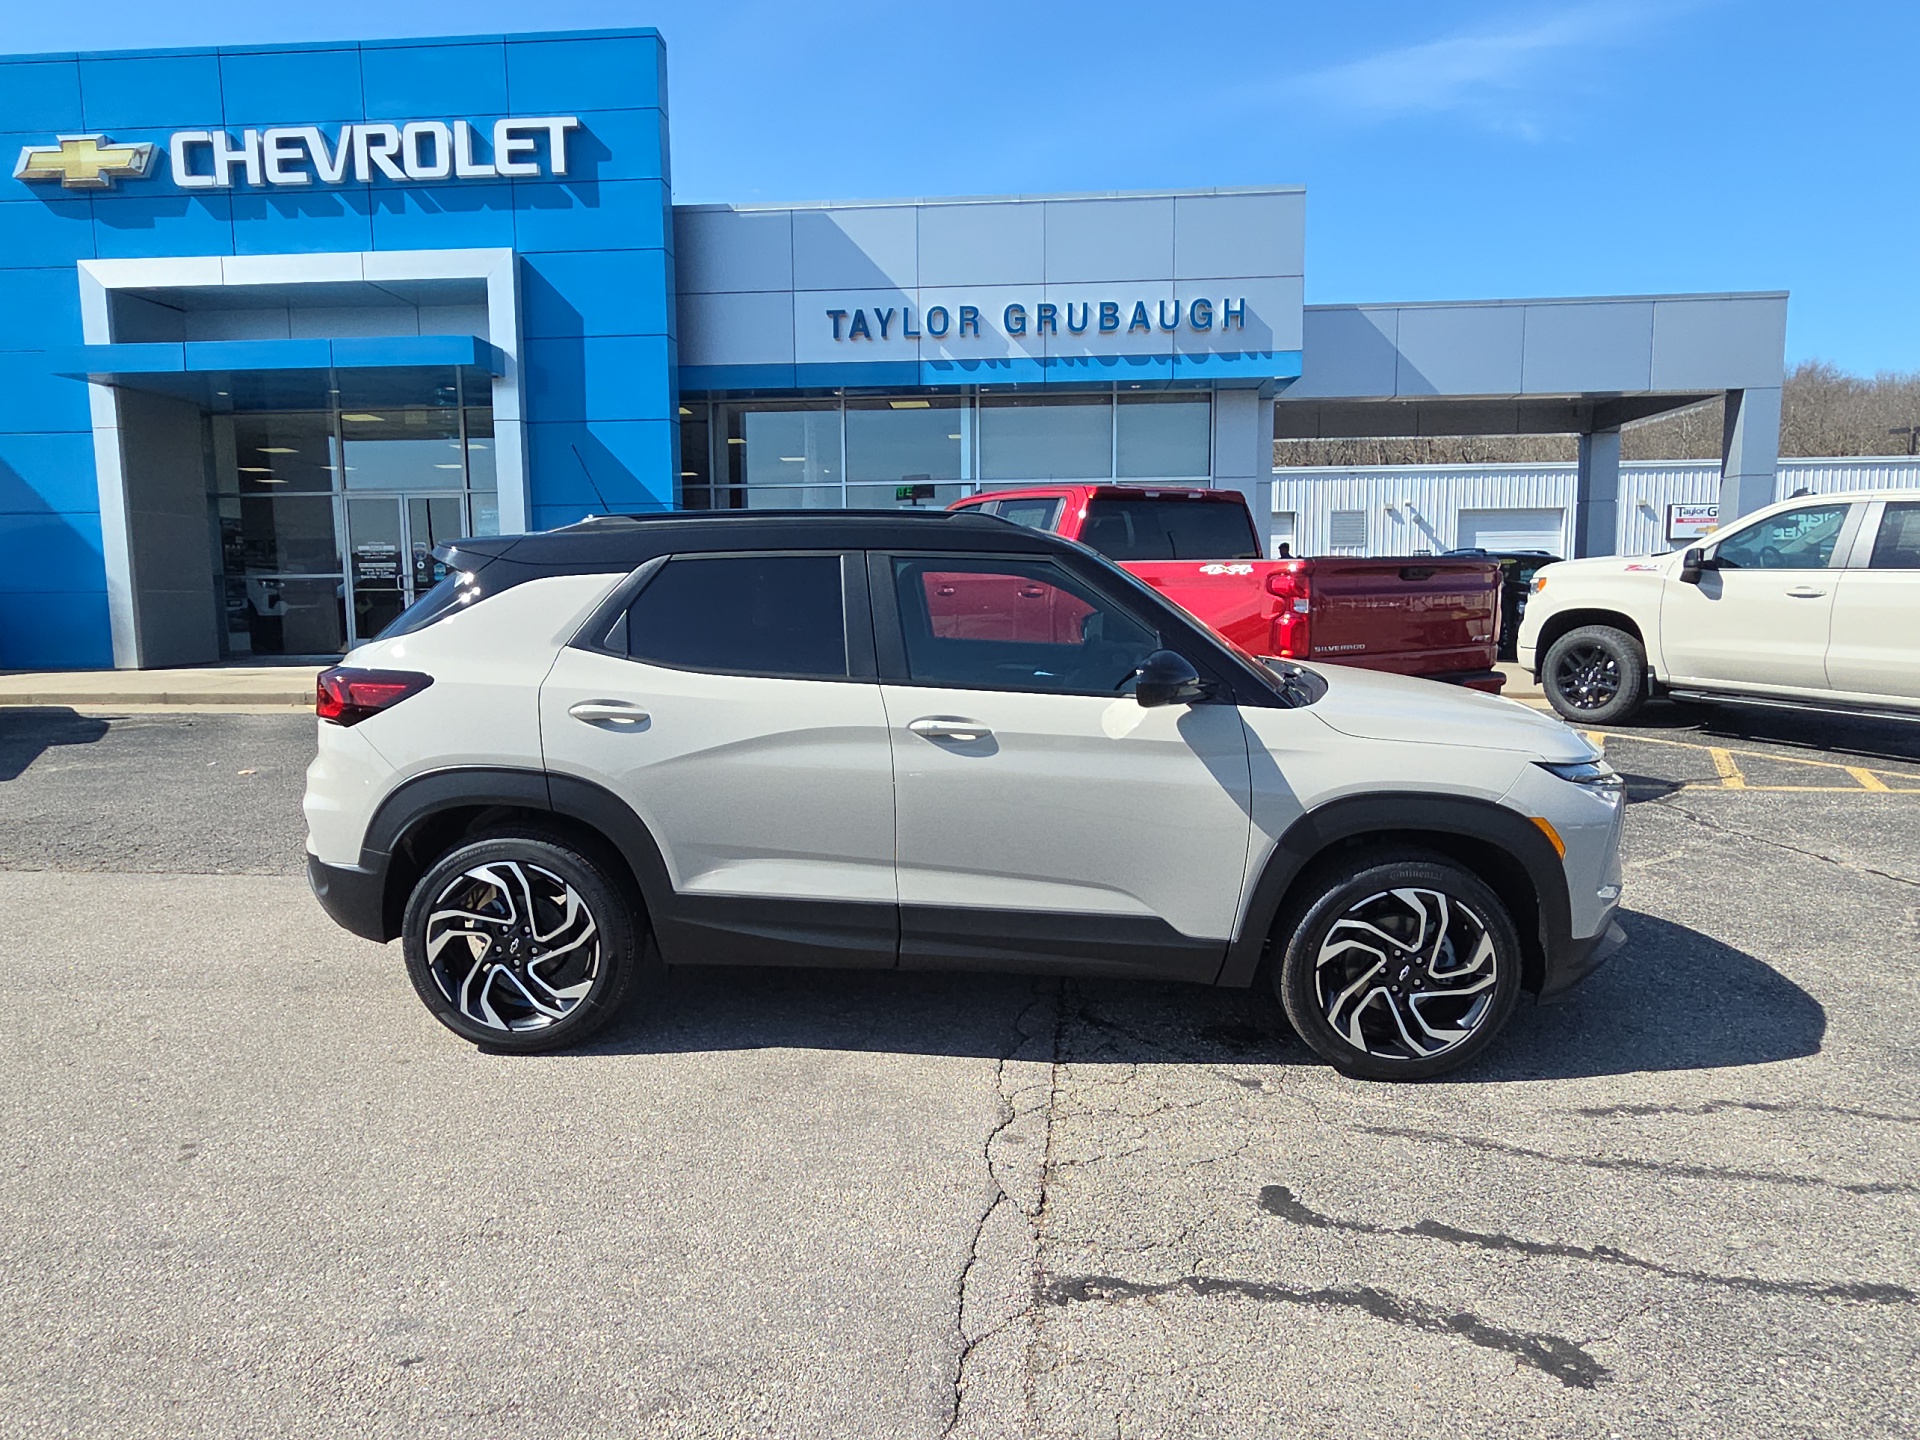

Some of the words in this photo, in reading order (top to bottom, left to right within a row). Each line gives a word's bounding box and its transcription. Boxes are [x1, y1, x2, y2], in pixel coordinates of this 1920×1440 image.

[169, 116, 578, 188] CHEVROLET
[826, 305, 980, 341] TAYLOR
[1002, 297, 1247, 336] GRUBAUGH
[1675, 506, 1706, 518] Taylor
[1707, 506, 1719, 517] G
[1314, 643, 1366, 653] SILVERADO
